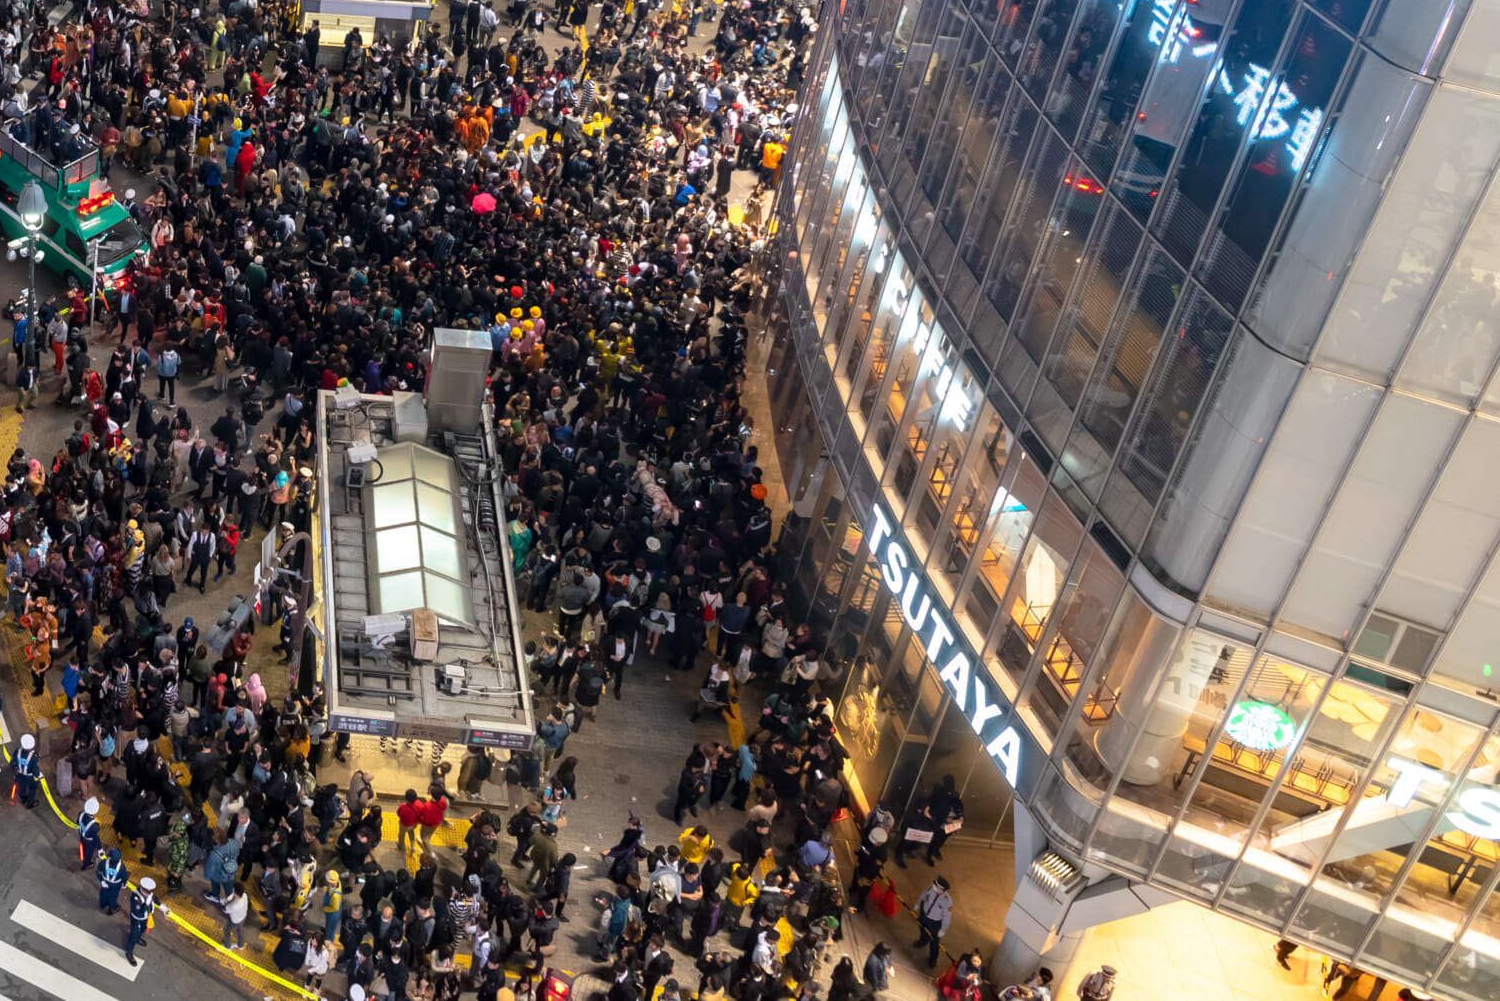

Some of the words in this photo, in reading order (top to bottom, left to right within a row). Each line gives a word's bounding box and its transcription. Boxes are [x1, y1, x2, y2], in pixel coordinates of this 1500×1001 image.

[869, 502, 1021, 789] TSUTAYA
[337, 722, 368, 732] 渋谷駅
